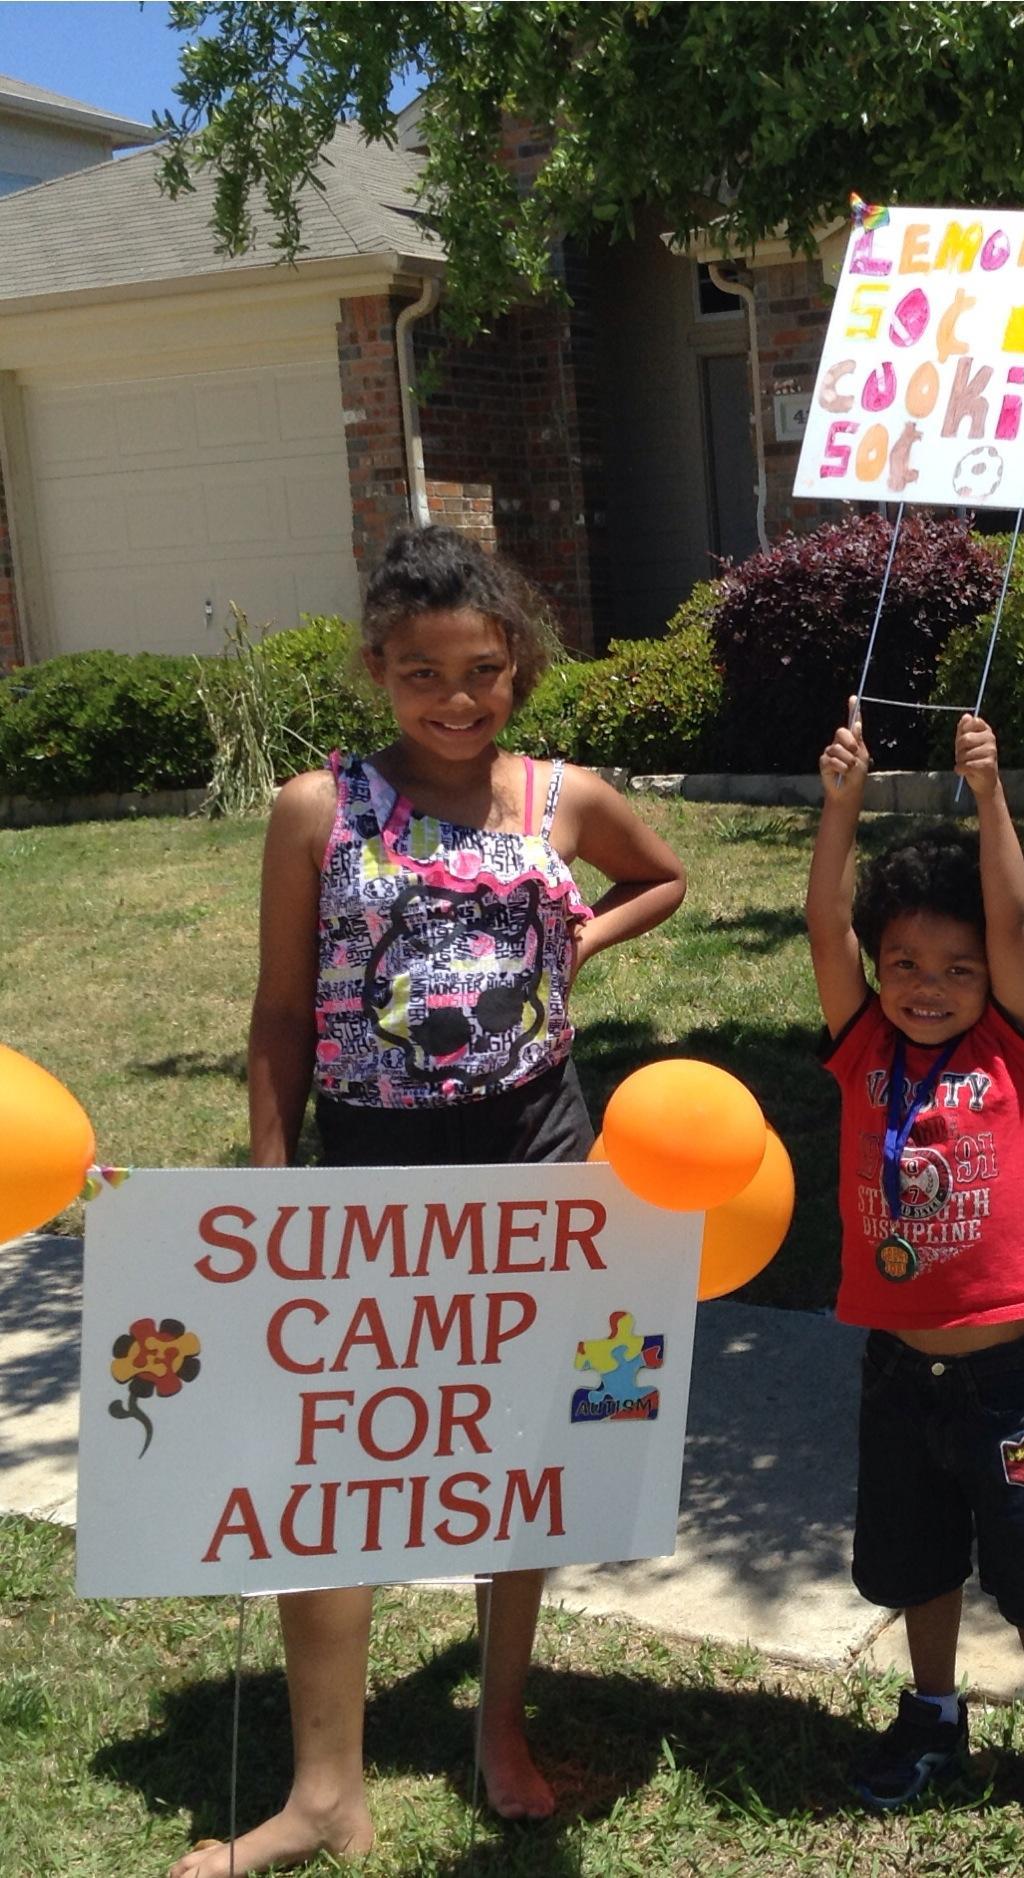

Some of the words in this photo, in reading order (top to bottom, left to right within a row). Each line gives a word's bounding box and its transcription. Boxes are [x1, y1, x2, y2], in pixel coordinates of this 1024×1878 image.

[194, 1199, 608, 1284] SUMMER
[266, 1291, 538, 1375] CAMP
[295, 1383, 493, 1466] FOR
[574, 1399, 653, 1417] AUTISM
[201, 1466, 567, 1562] AUTISM
